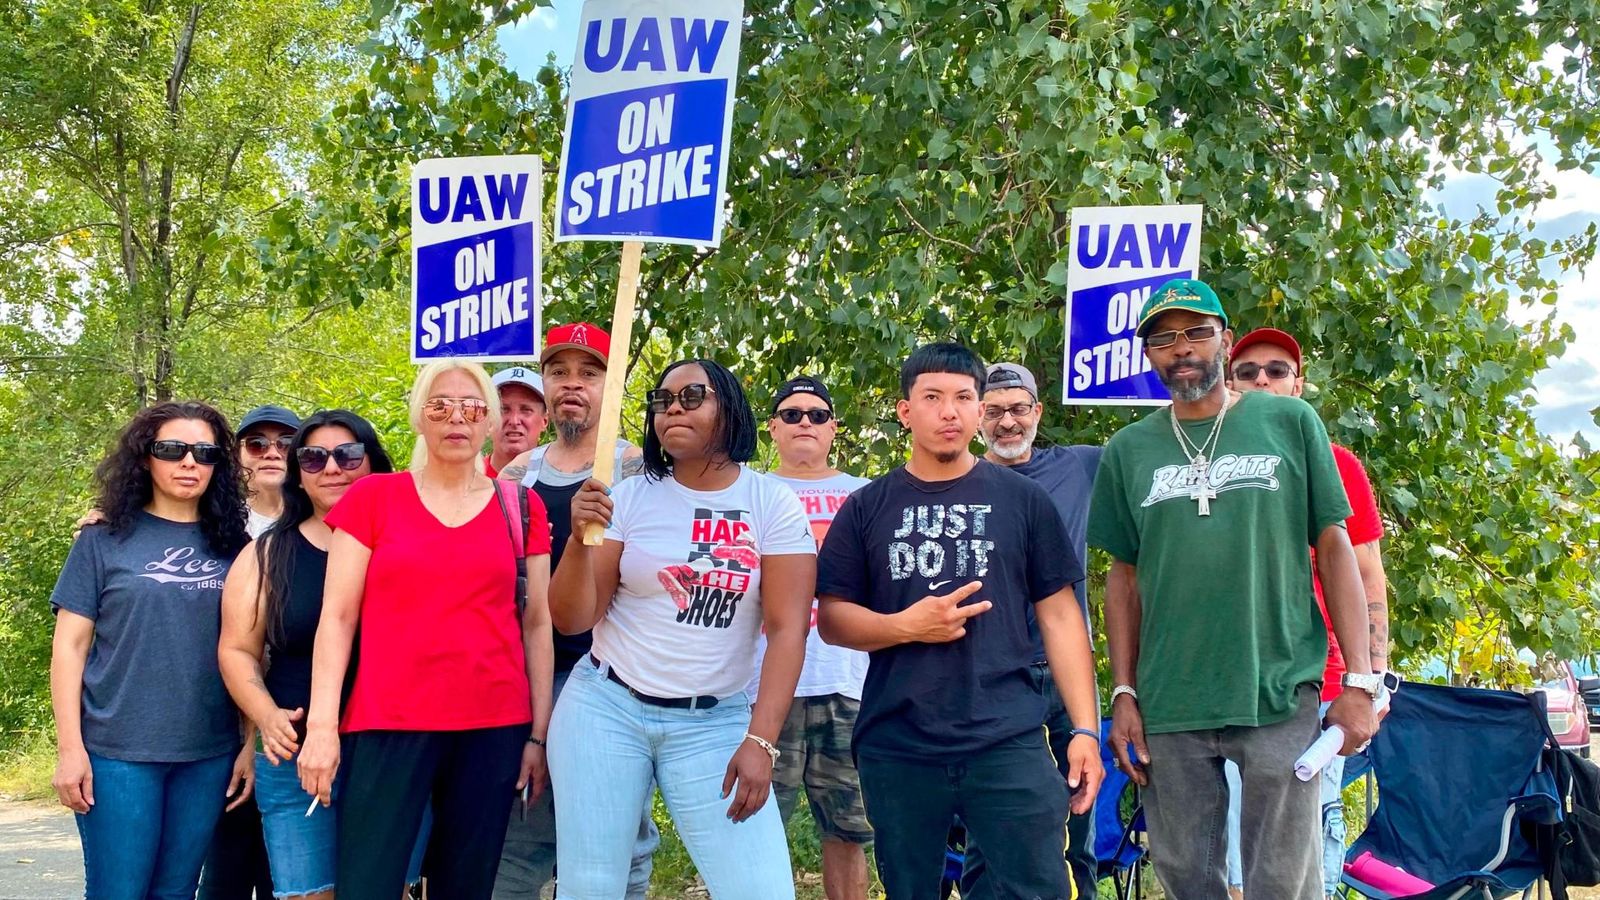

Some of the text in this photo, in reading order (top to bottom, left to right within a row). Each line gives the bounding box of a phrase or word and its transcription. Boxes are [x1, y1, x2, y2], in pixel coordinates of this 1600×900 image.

[584, 17, 729, 73] UAW
[617, 93, 675, 154] ON
[419, 173, 529, 224] UAW
[568, 144, 714, 226] STRIKE
[454, 239, 495, 292] ON
[1077, 223, 1191, 269] UAW
[421, 277, 528, 350] STRIKE
[1107, 285, 1151, 335] ON
[1073, 335, 1152, 391] STRI
[1146, 454, 1281, 499] RACATS
[894, 504, 991, 538] JUST
[145, 547, 222, 573] Lee
[197, 579, 224, 589] 1889
[888, 540, 995, 580] DO IT
